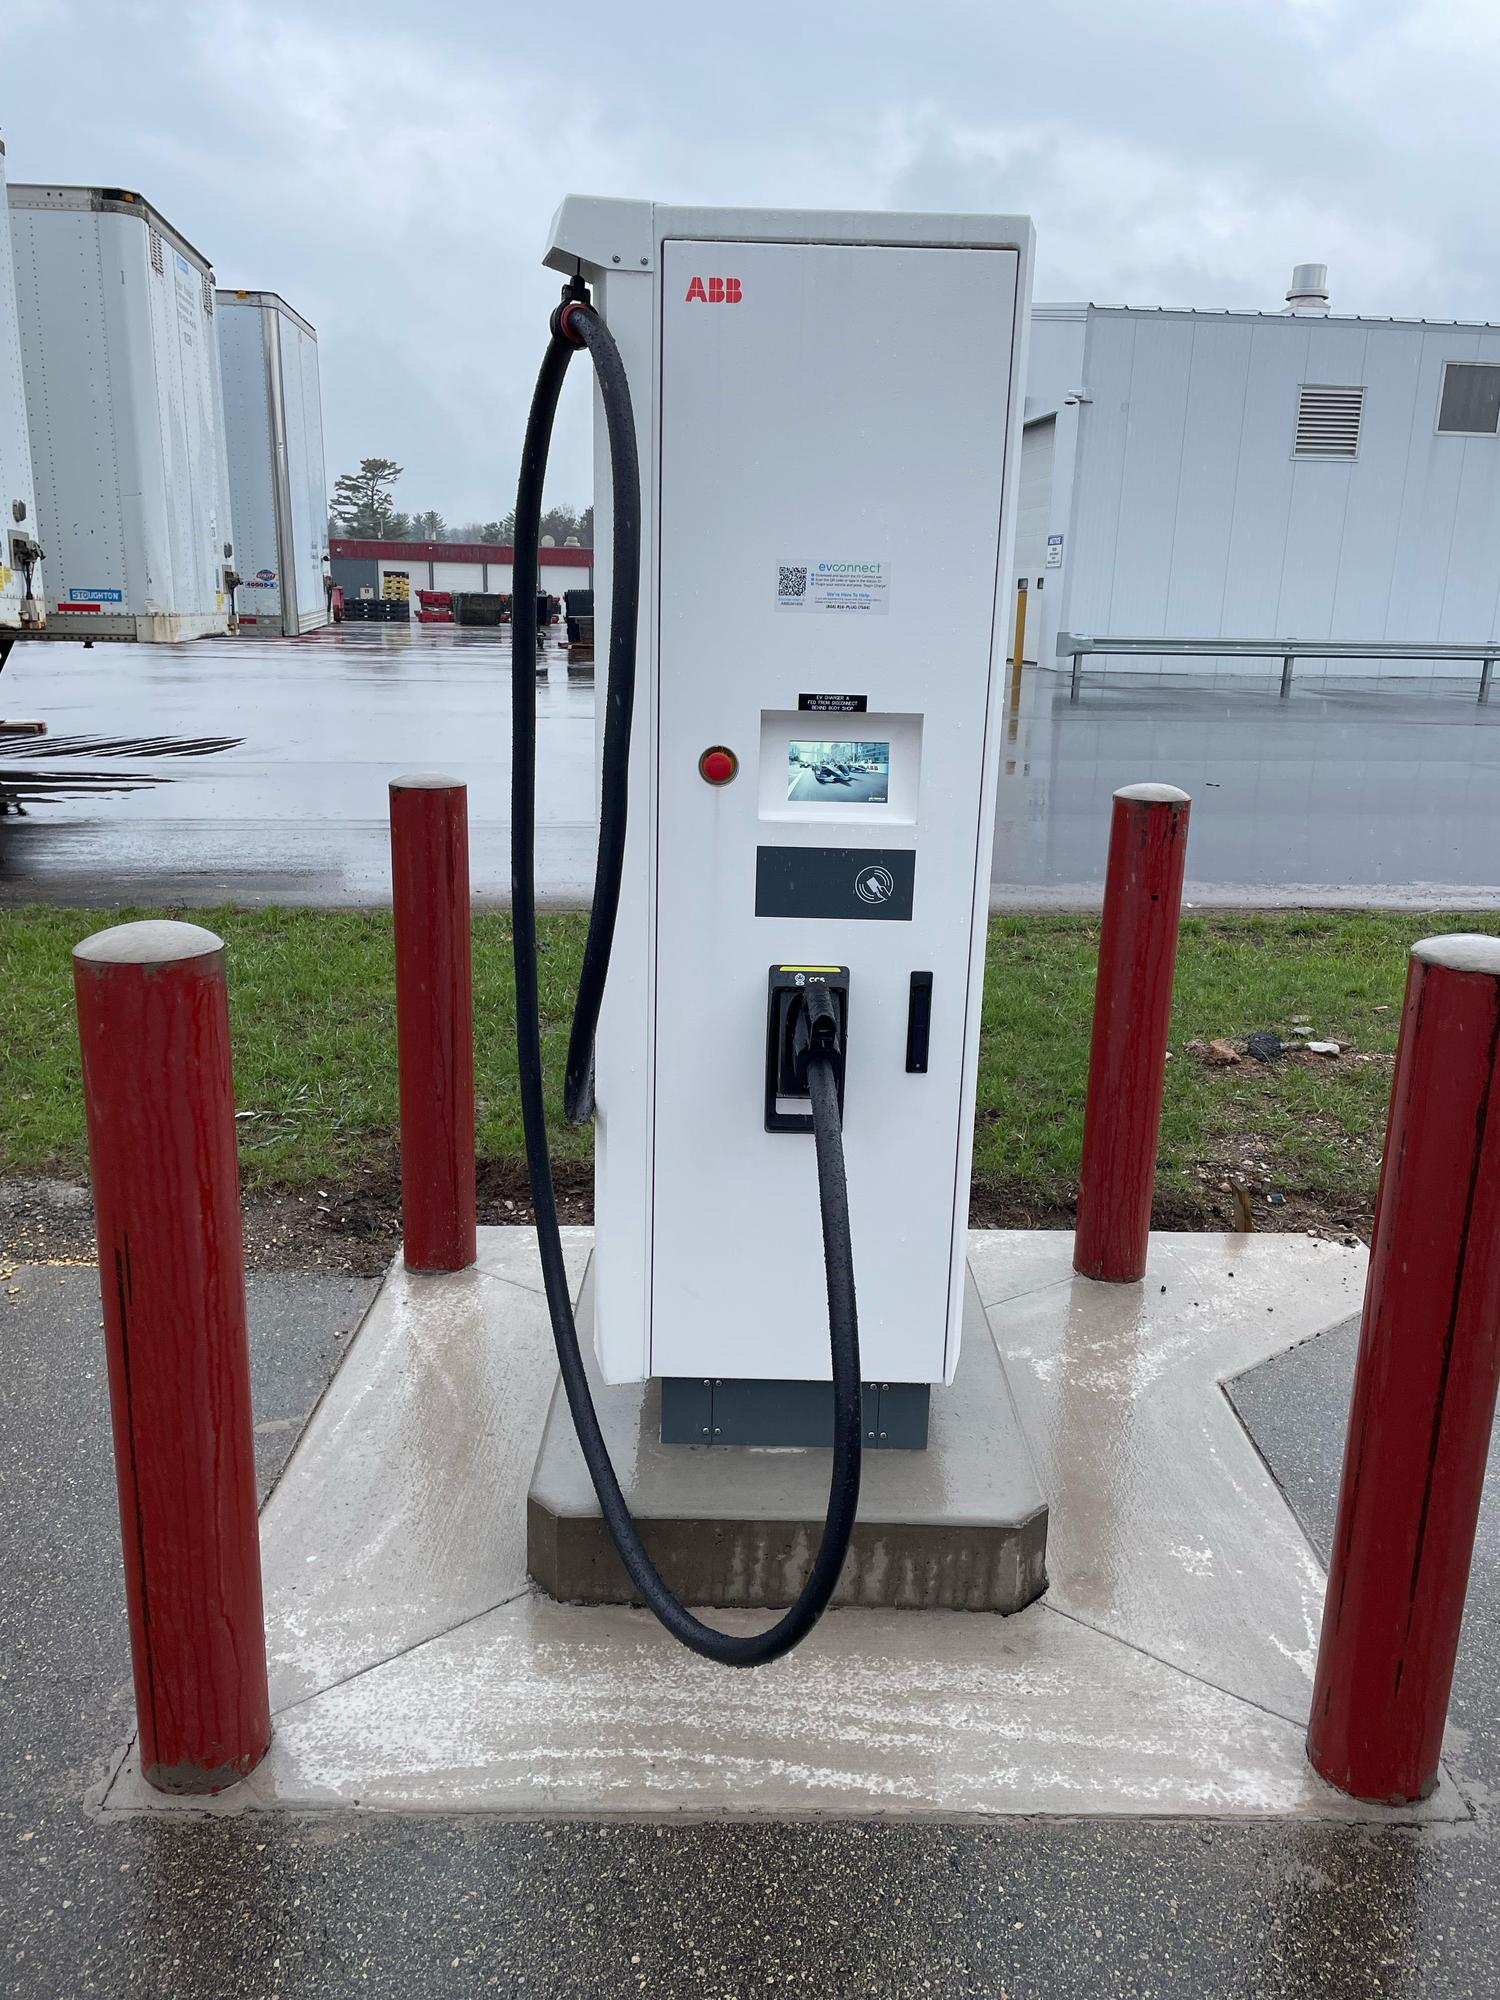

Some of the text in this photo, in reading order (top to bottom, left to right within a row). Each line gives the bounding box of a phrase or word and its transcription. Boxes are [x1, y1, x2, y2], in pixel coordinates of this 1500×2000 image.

[685, 277, 743, 303] ABB
[818, 562, 881, 574] evconnect
[72, 590, 119, 600] STOUGHTON
